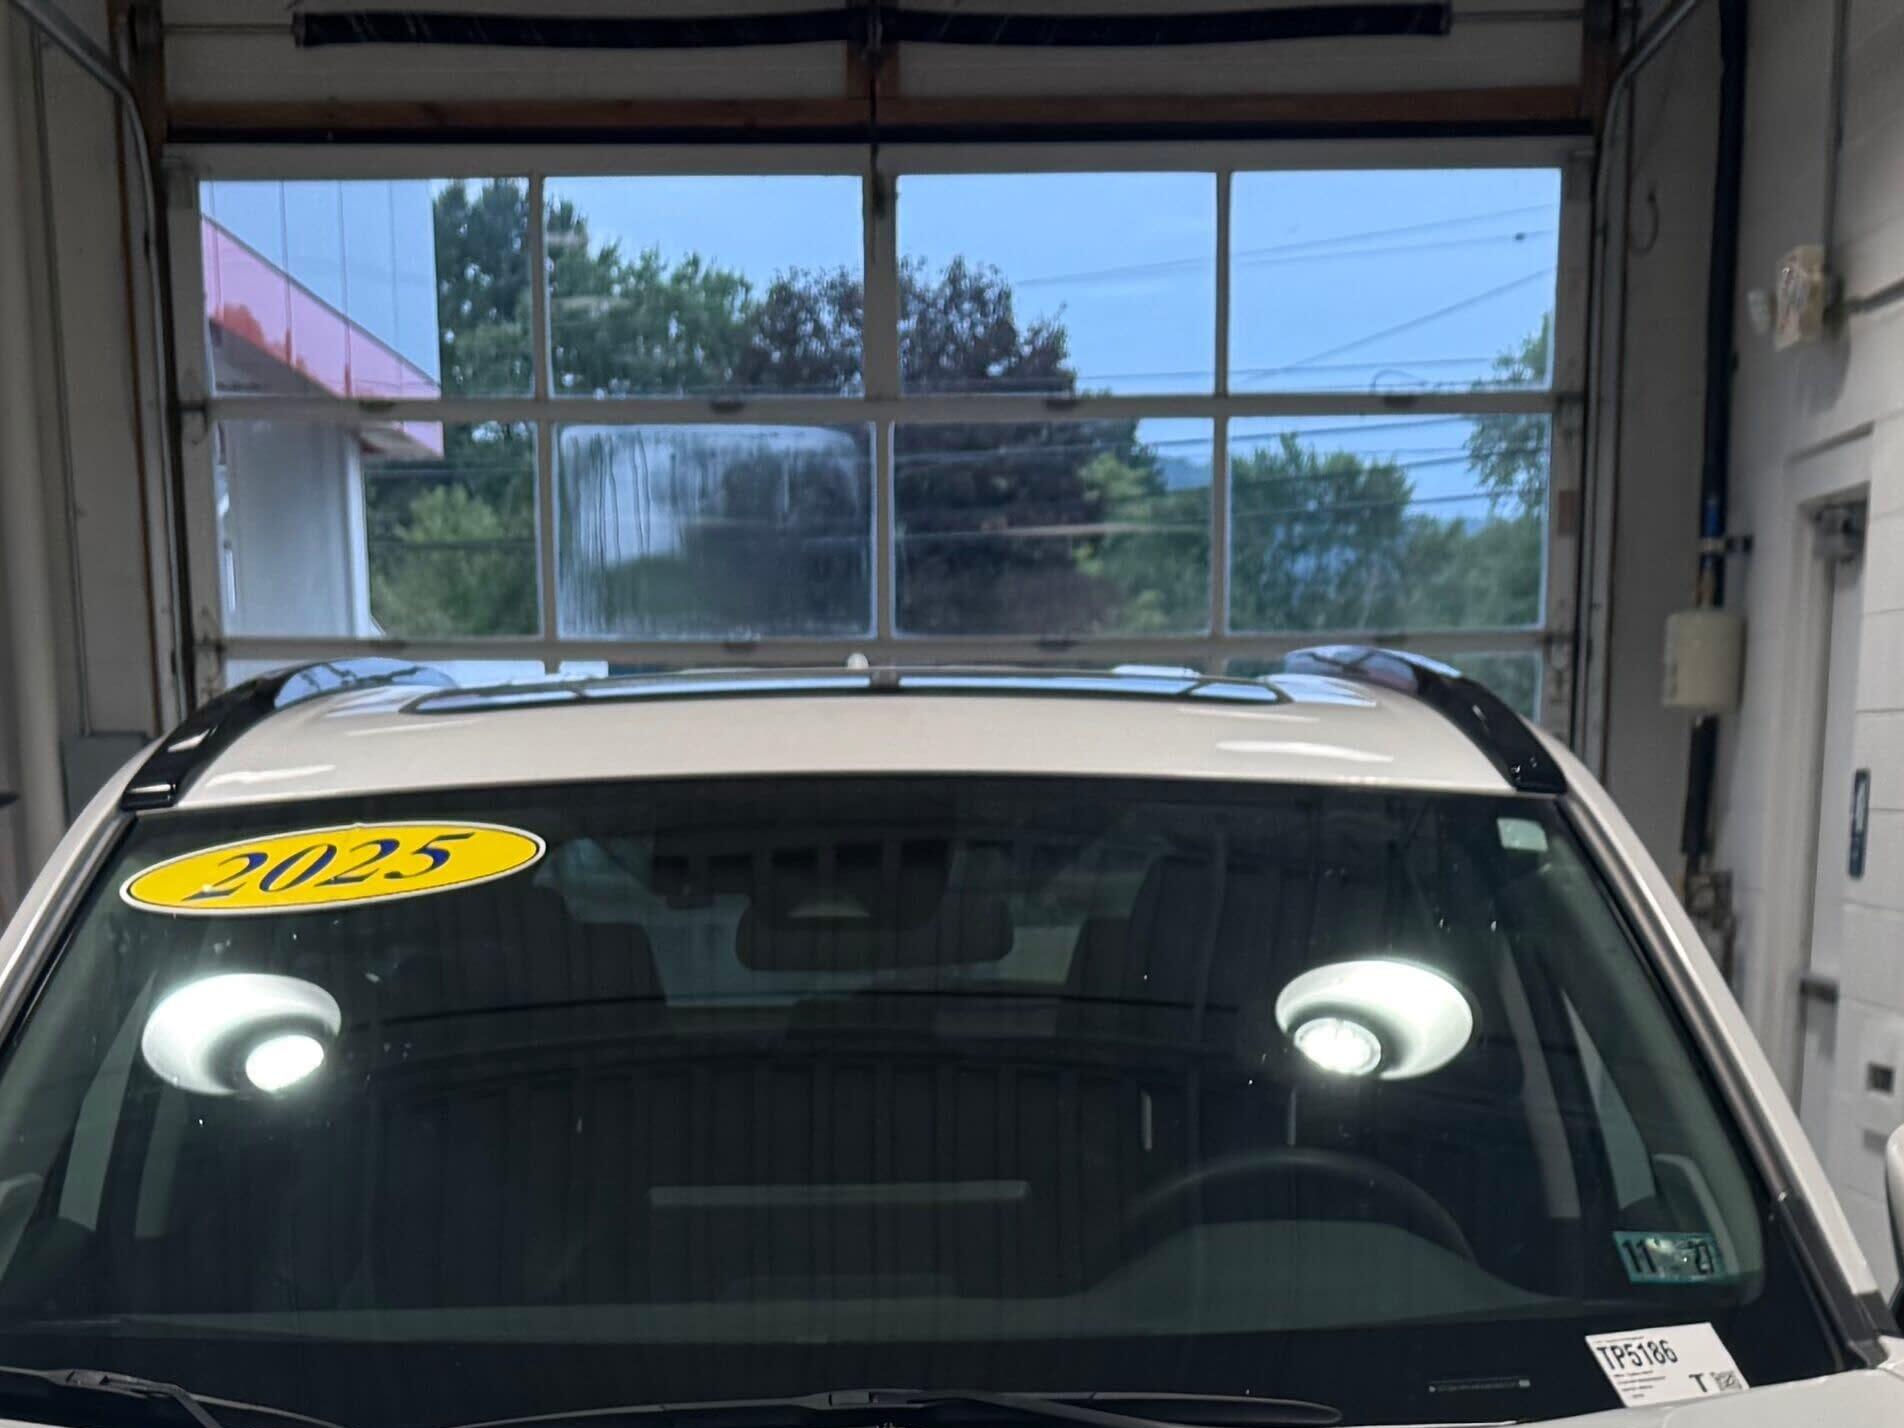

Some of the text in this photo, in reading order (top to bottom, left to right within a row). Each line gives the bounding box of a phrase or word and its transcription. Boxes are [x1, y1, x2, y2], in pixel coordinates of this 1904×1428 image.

[180, 831, 475, 902] 2025
[1621, 1240, 1657, 1273] 11
[1596, 1340, 1678, 1371] TP5186
[1688, 1372, 1708, 1393] T
